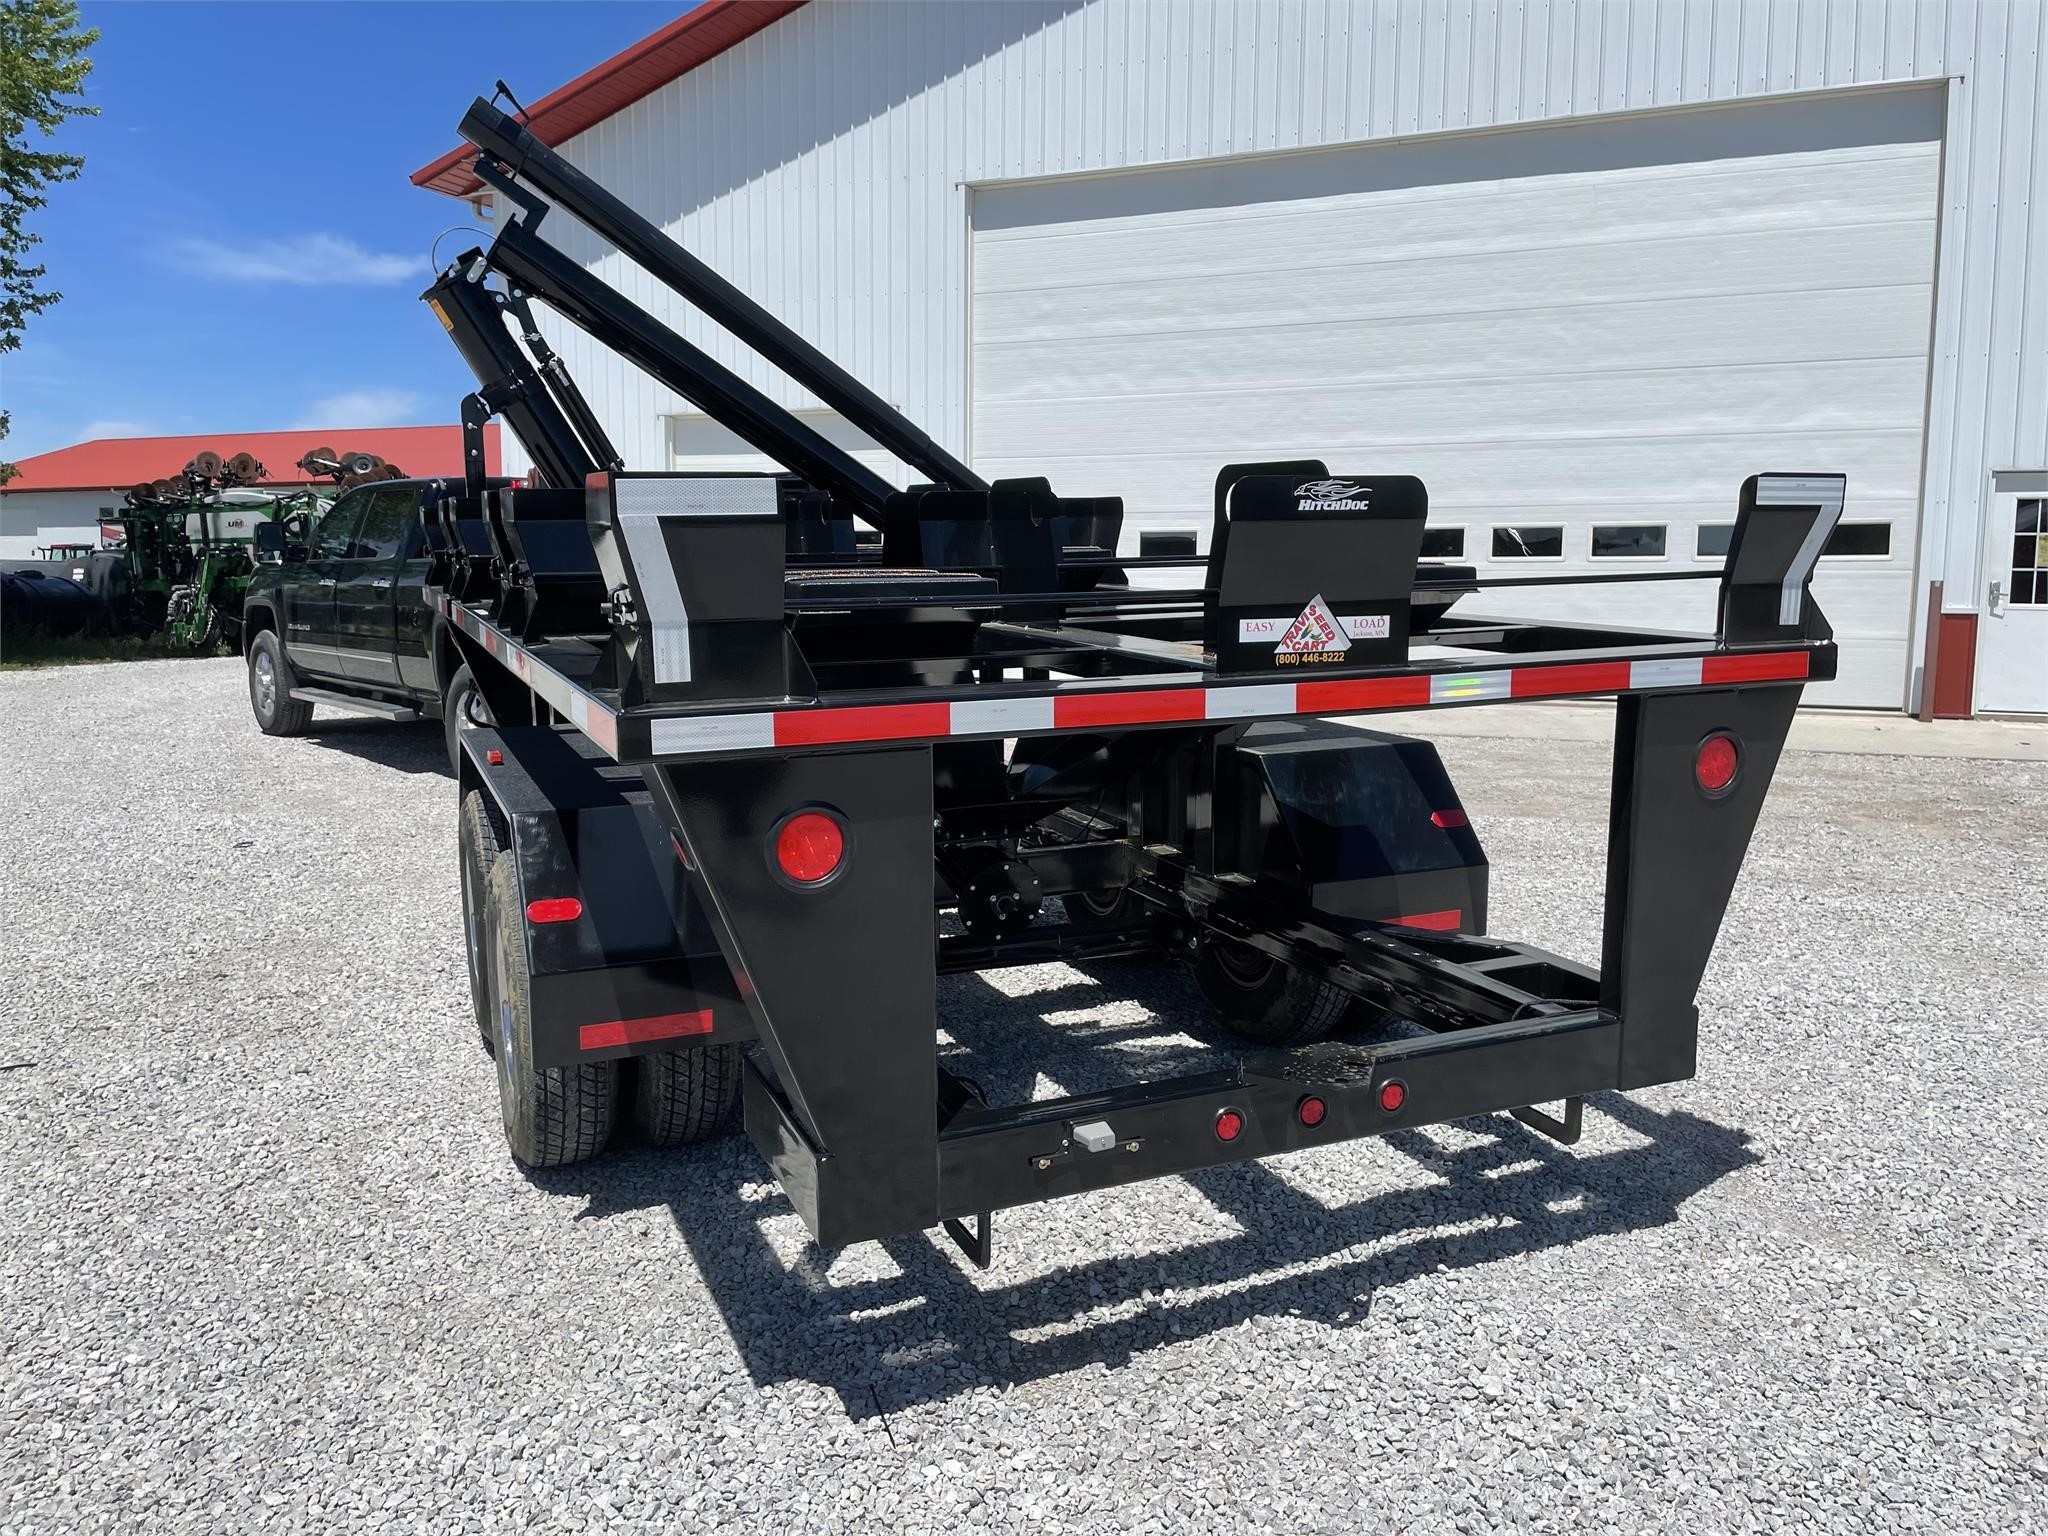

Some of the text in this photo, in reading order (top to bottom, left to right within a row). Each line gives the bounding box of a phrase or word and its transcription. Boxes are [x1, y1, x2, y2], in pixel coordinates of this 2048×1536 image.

[228, 518, 245, 529] UM
[1246, 618, 1385, 632] EASY LOAD
[1291, 640, 1329, 651] CART
[1275, 652, 1345, 666] (800) 446-8222
